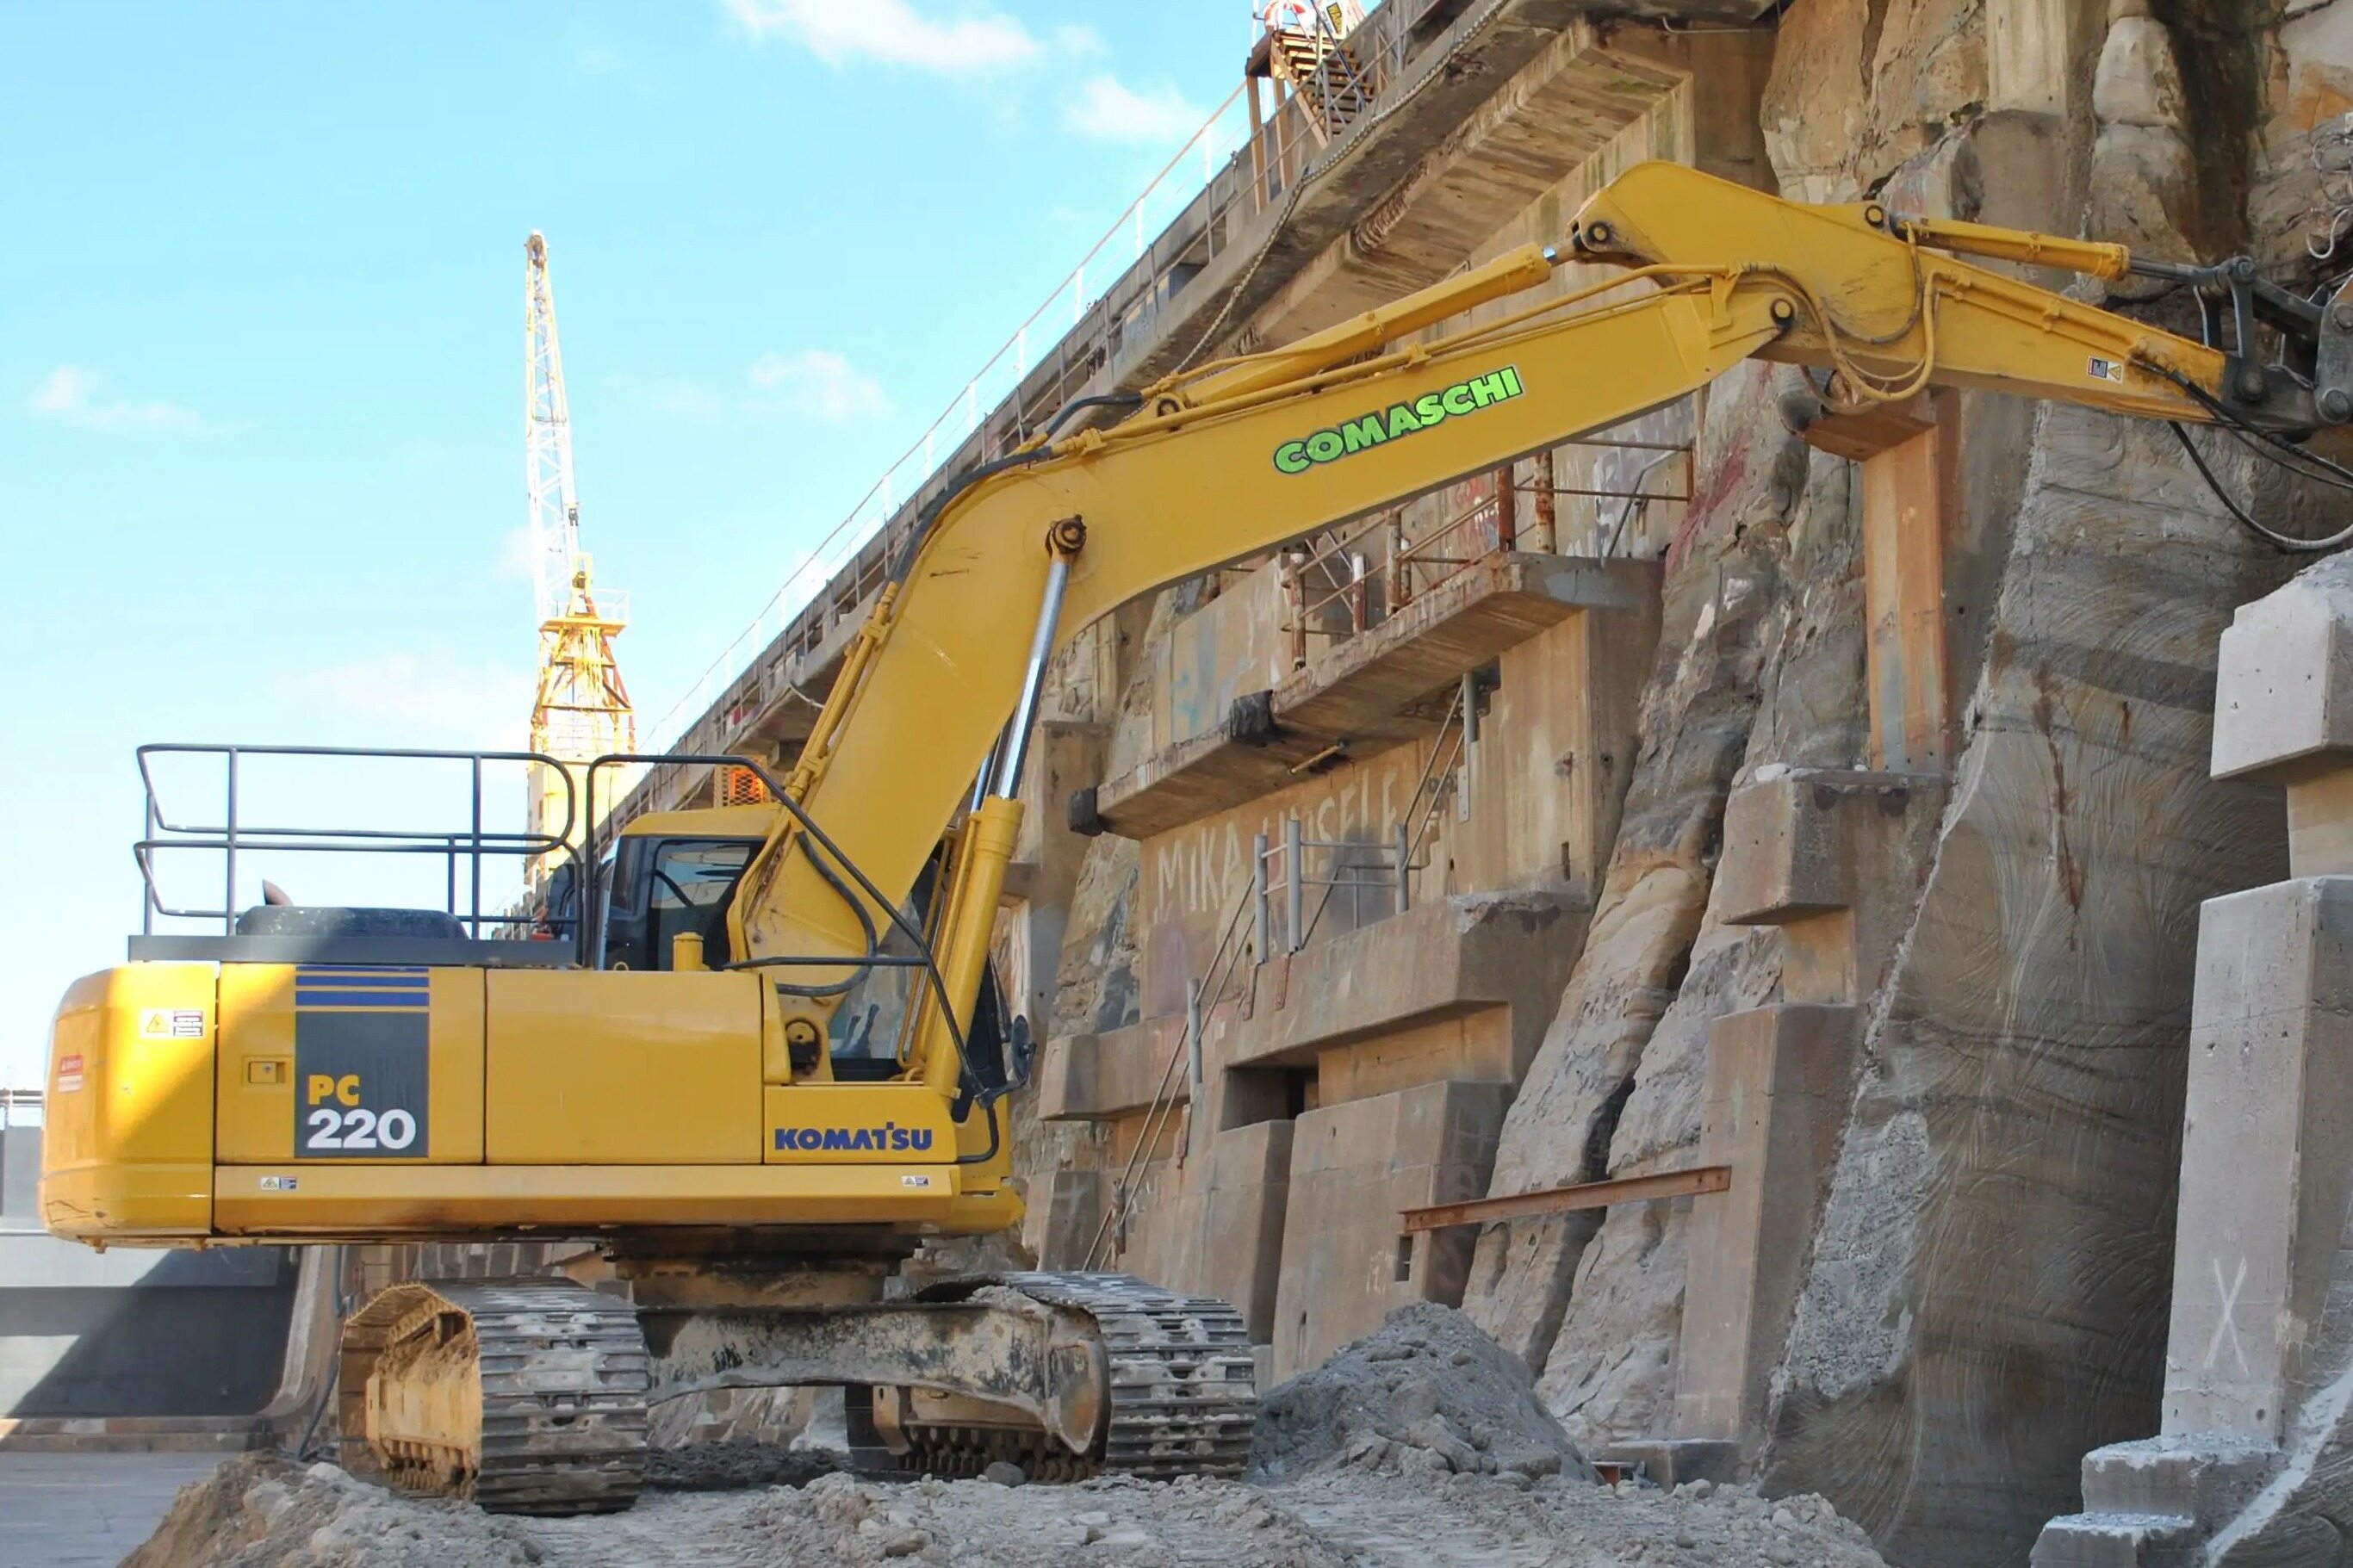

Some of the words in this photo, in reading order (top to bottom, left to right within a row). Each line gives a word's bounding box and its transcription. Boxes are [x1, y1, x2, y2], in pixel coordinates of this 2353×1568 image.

[1274, 366, 1524, 474] COMASCHI
[1158, 820, 1241, 913] MIKA
[308, 1074, 360, 1106] PC
[307, 1108, 417, 1150] 220
[774, 1121, 932, 1150] KOMATSU
